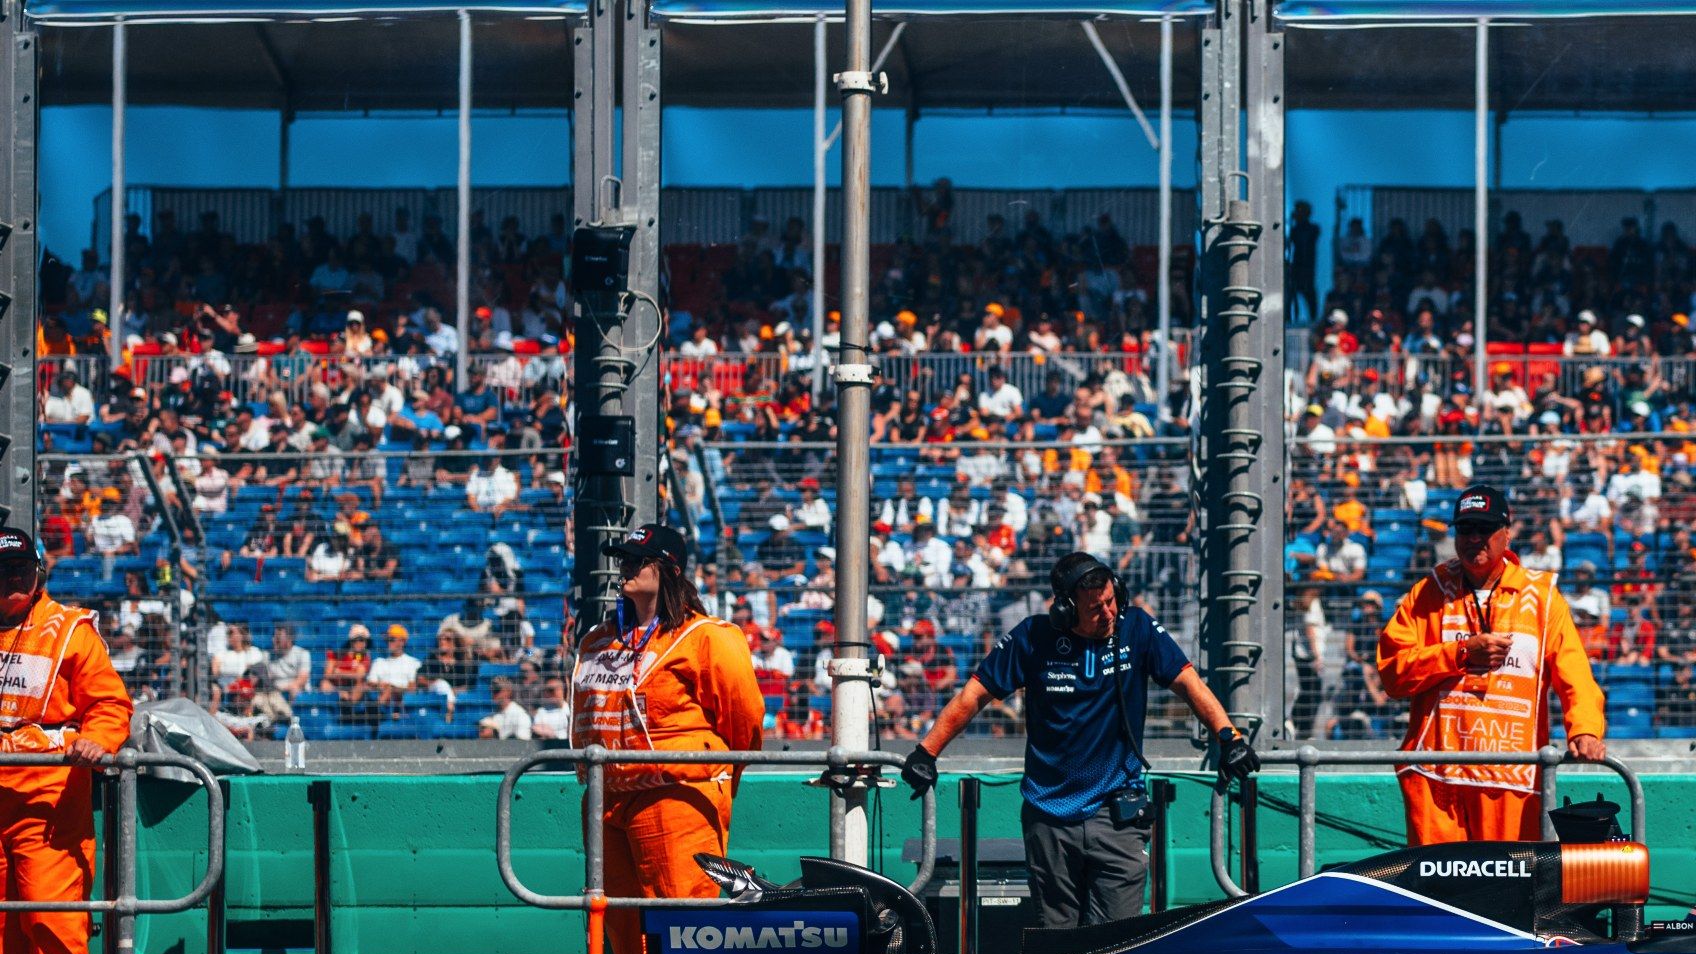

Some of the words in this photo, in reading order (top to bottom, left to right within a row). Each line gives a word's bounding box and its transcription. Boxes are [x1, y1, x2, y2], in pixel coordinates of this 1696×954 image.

[1418, 860, 1532, 878] DURACELL
[669, 920, 849, 950] KOMATSU
[1666, 922, 1694, 930] ALBON
